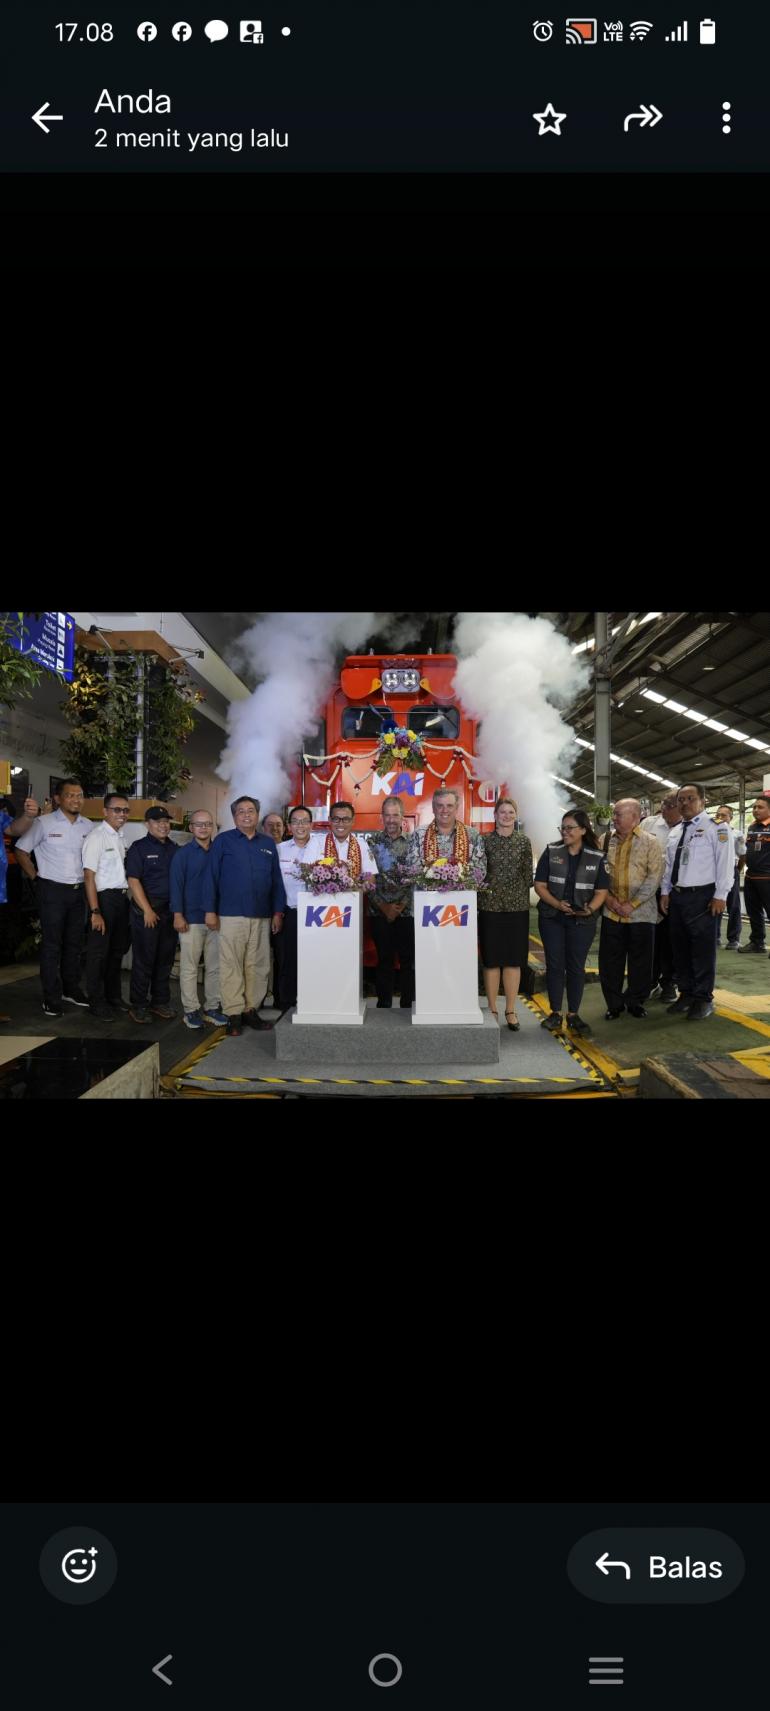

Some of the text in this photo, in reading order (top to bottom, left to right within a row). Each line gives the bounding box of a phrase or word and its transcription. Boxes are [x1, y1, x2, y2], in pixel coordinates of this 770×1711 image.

[371, 772, 425, 796] KAI
[305, 905, 352, 928] KAI
[422, 904, 469, 927] KAI
